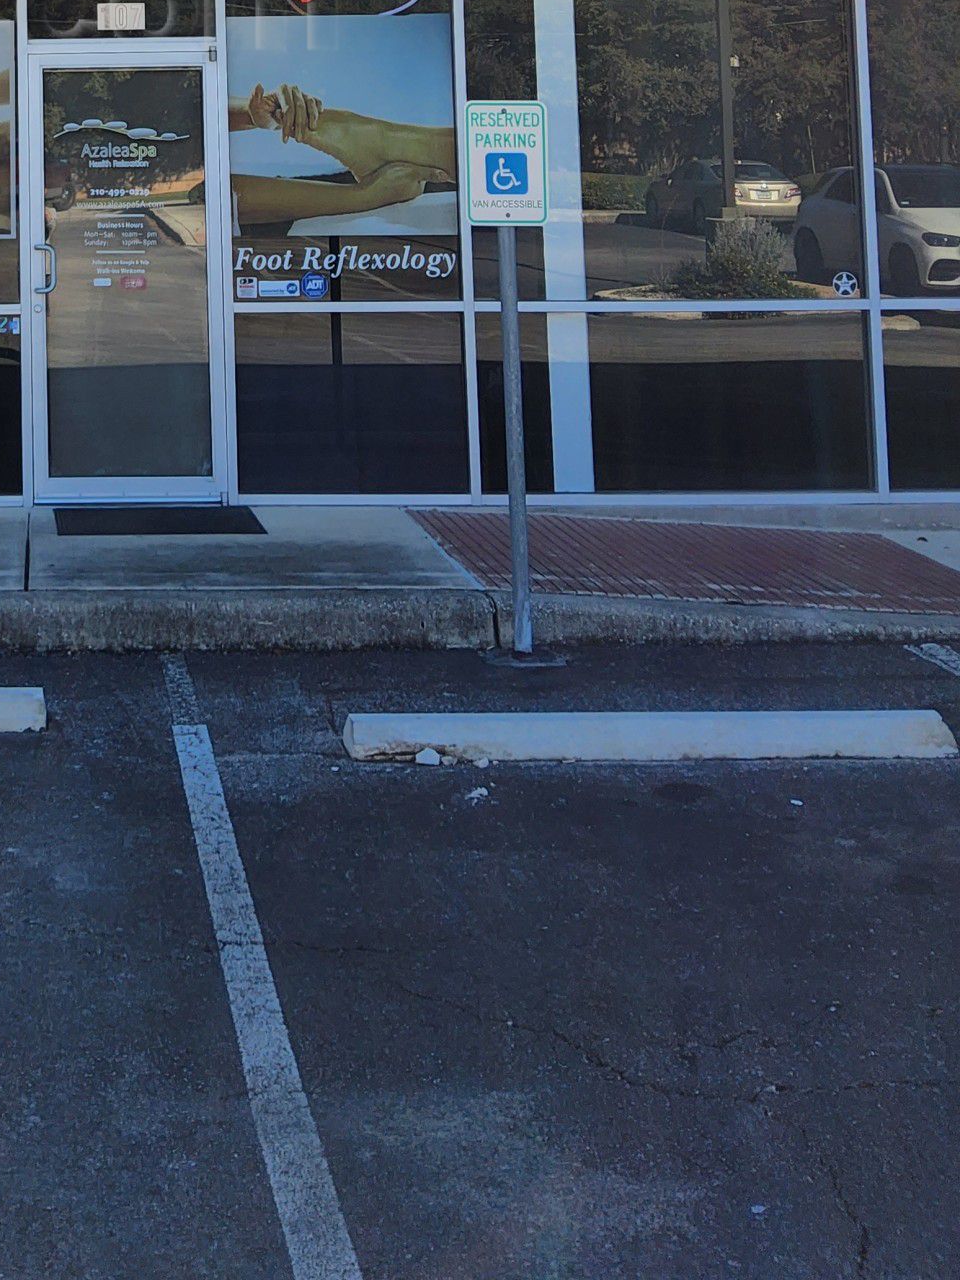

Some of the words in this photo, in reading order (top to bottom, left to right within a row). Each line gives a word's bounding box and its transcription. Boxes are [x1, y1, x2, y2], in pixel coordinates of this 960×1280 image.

[470, 112, 540, 128] RESERVED
[475, 133, 537, 149] PARKING
[472, 200, 489, 208] VAN
[490, 199, 543, 209] ACCESSIBLE
[234, 247, 293, 271] Foot
[301, 245, 457, 279] Reflexology
[305, 279, 324, 290] ADT
